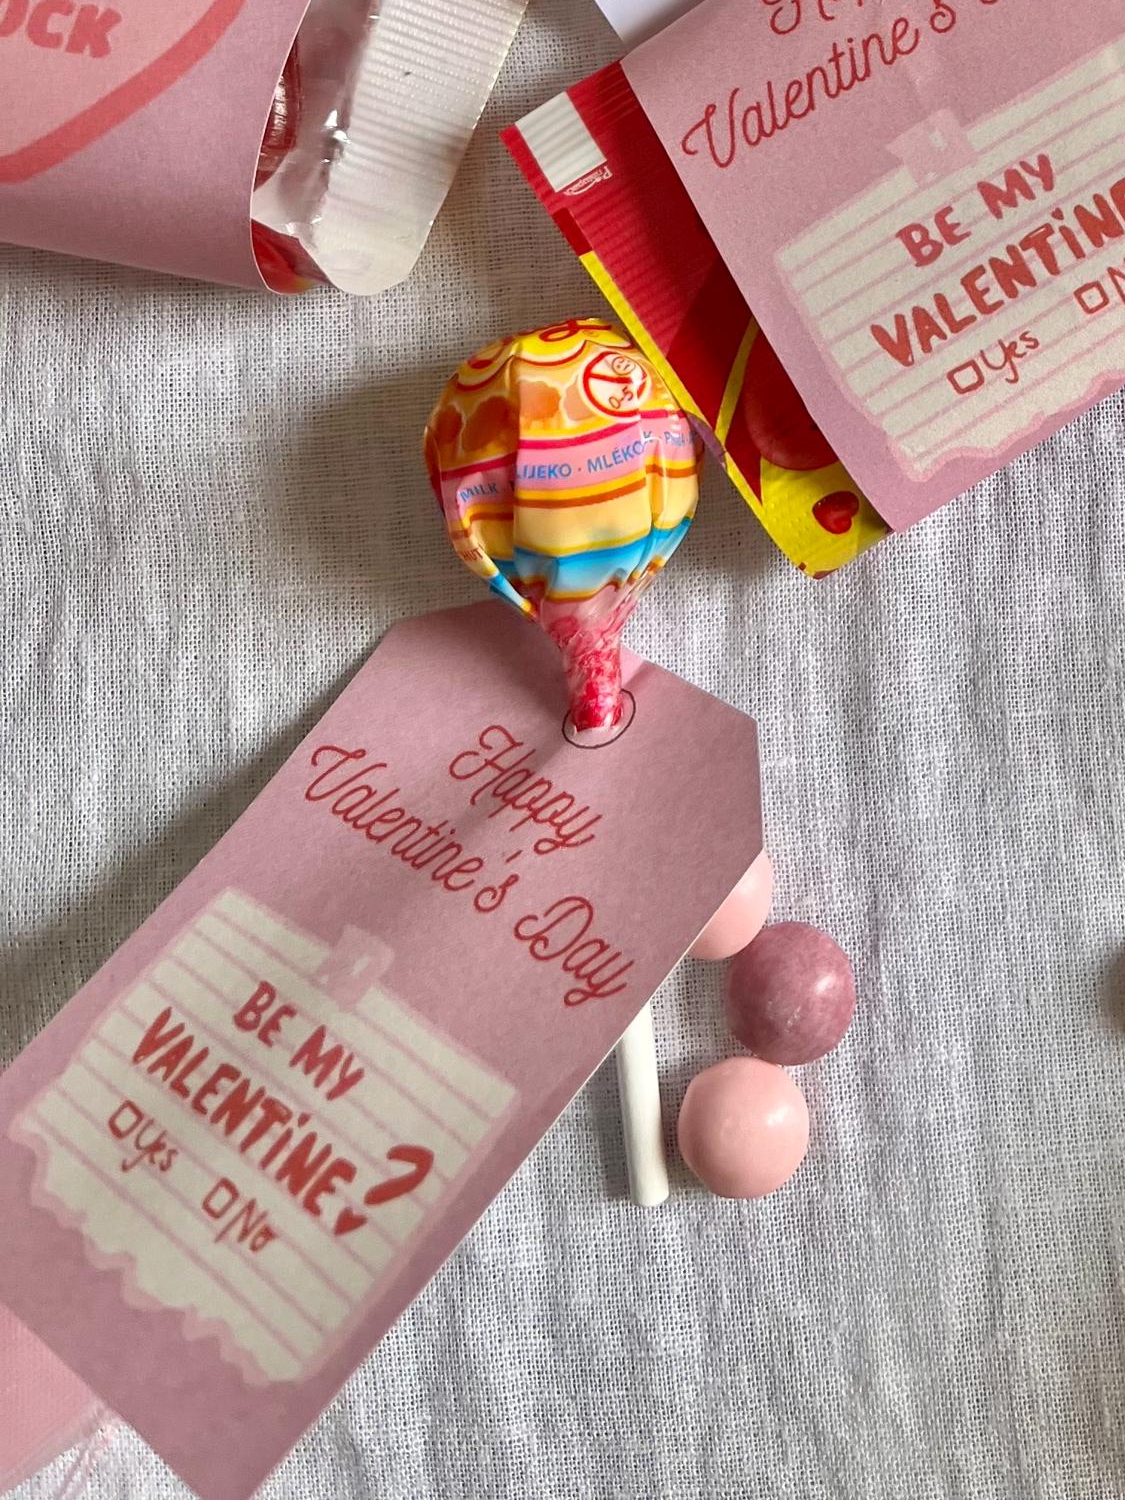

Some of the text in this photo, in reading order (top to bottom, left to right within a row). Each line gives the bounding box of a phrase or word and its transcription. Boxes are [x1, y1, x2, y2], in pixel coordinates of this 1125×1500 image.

[895, 154, 1055, 268] BE MY
[981, 329, 1041, 384] Yes
[449, 724, 602, 855] Happy
[306, 744, 634, 1006] Valentine's Day
[234, 981, 365, 1100] BE MY
[120, 1117, 277, 1253] Yes No
